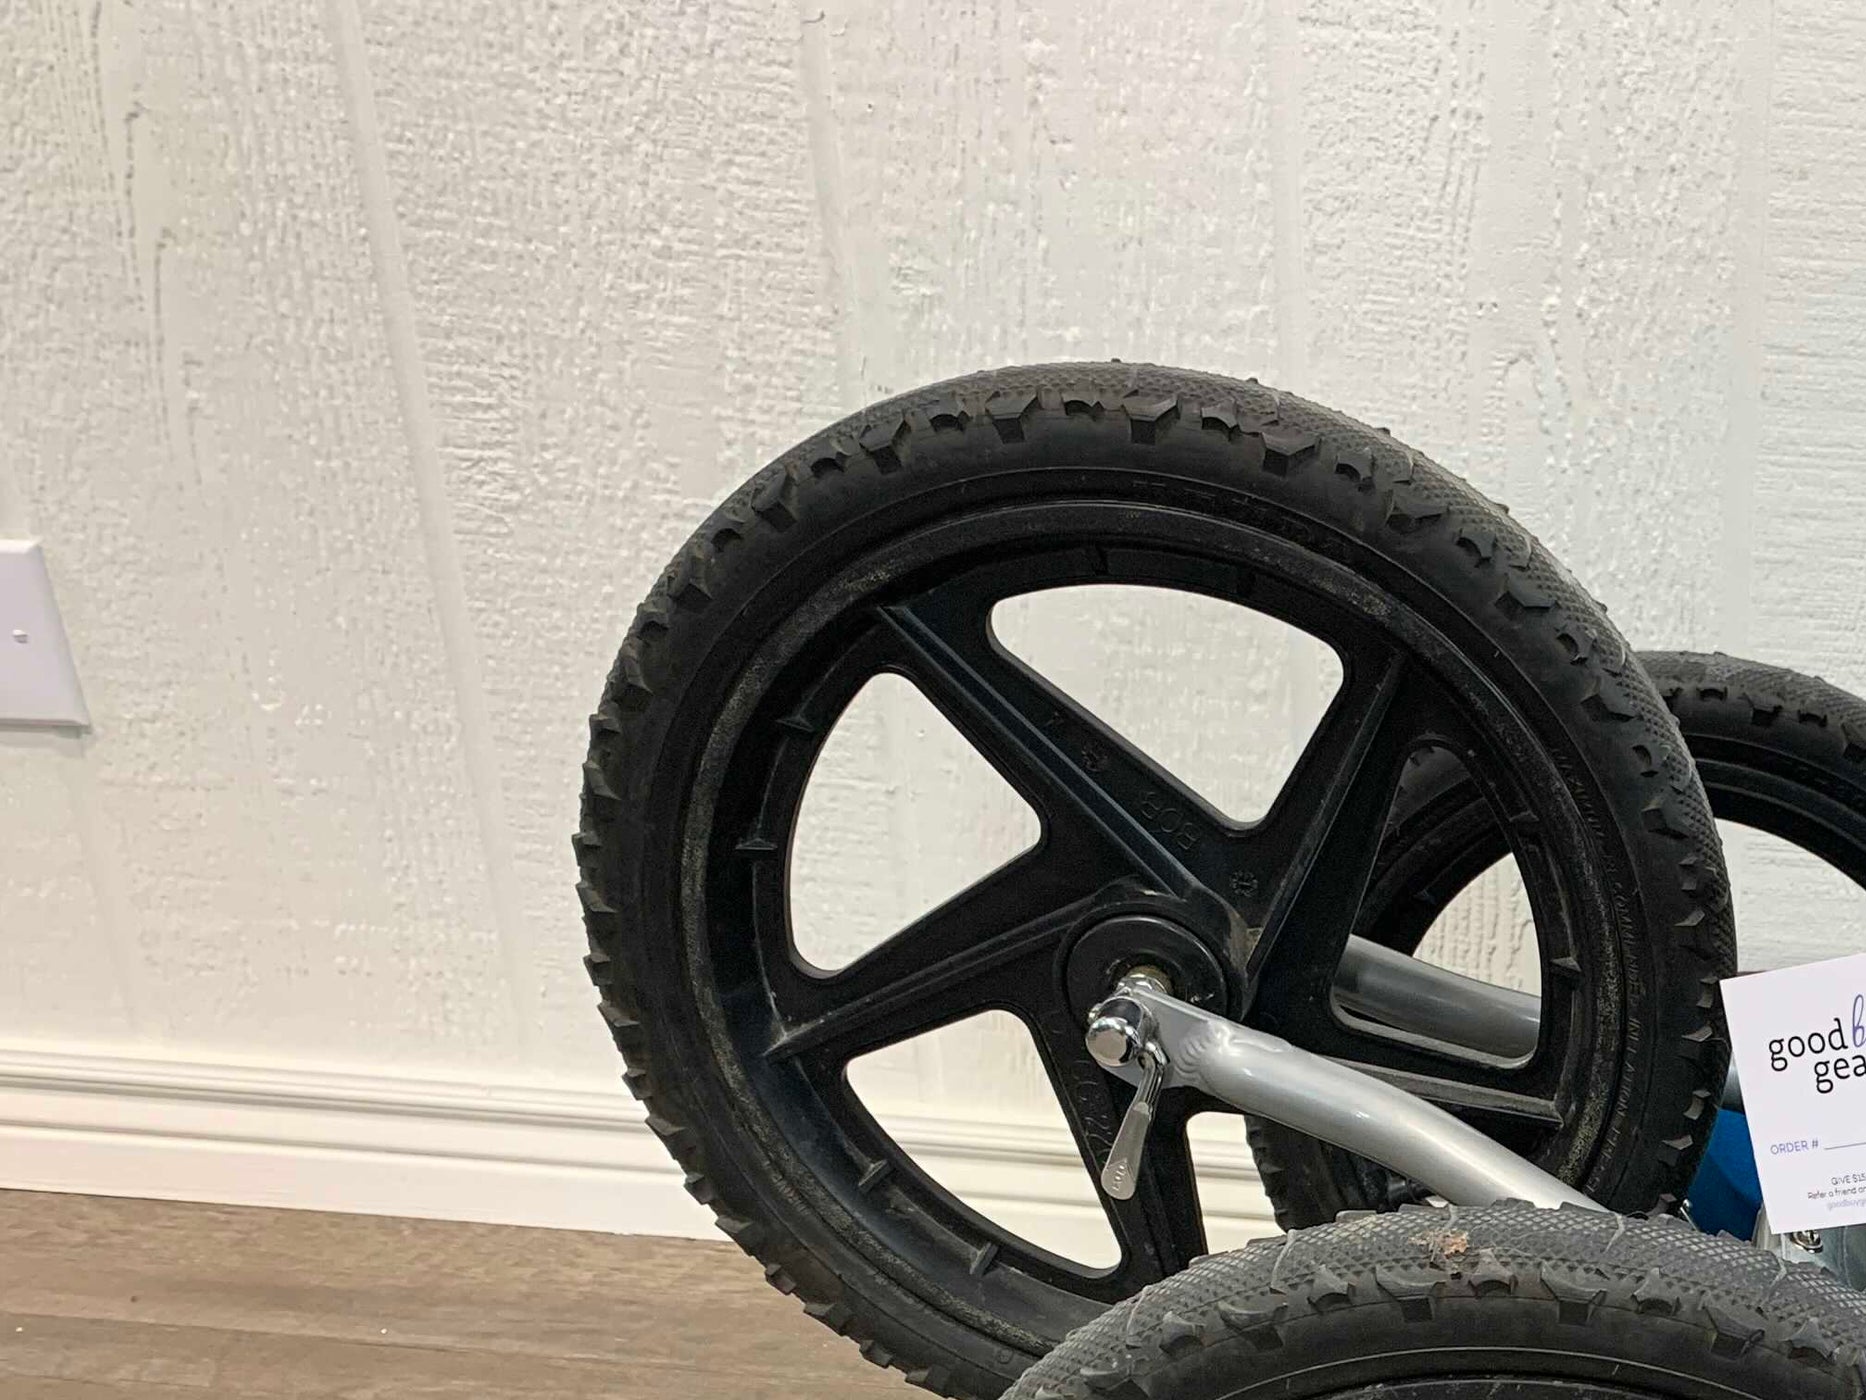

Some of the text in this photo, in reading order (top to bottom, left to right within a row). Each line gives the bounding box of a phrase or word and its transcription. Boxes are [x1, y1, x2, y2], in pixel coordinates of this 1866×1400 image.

[1768, 1017, 1849, 1072] good
[1770, 1138, 1819, 1155] ORDER #
[1830, 1174, 1850, 1186] GIVE
[1807, 1189, 1827, 1200] Refer
[1828, 1190, 1834, 1198] a
[1834, 1186, 1857, 1197] friend
